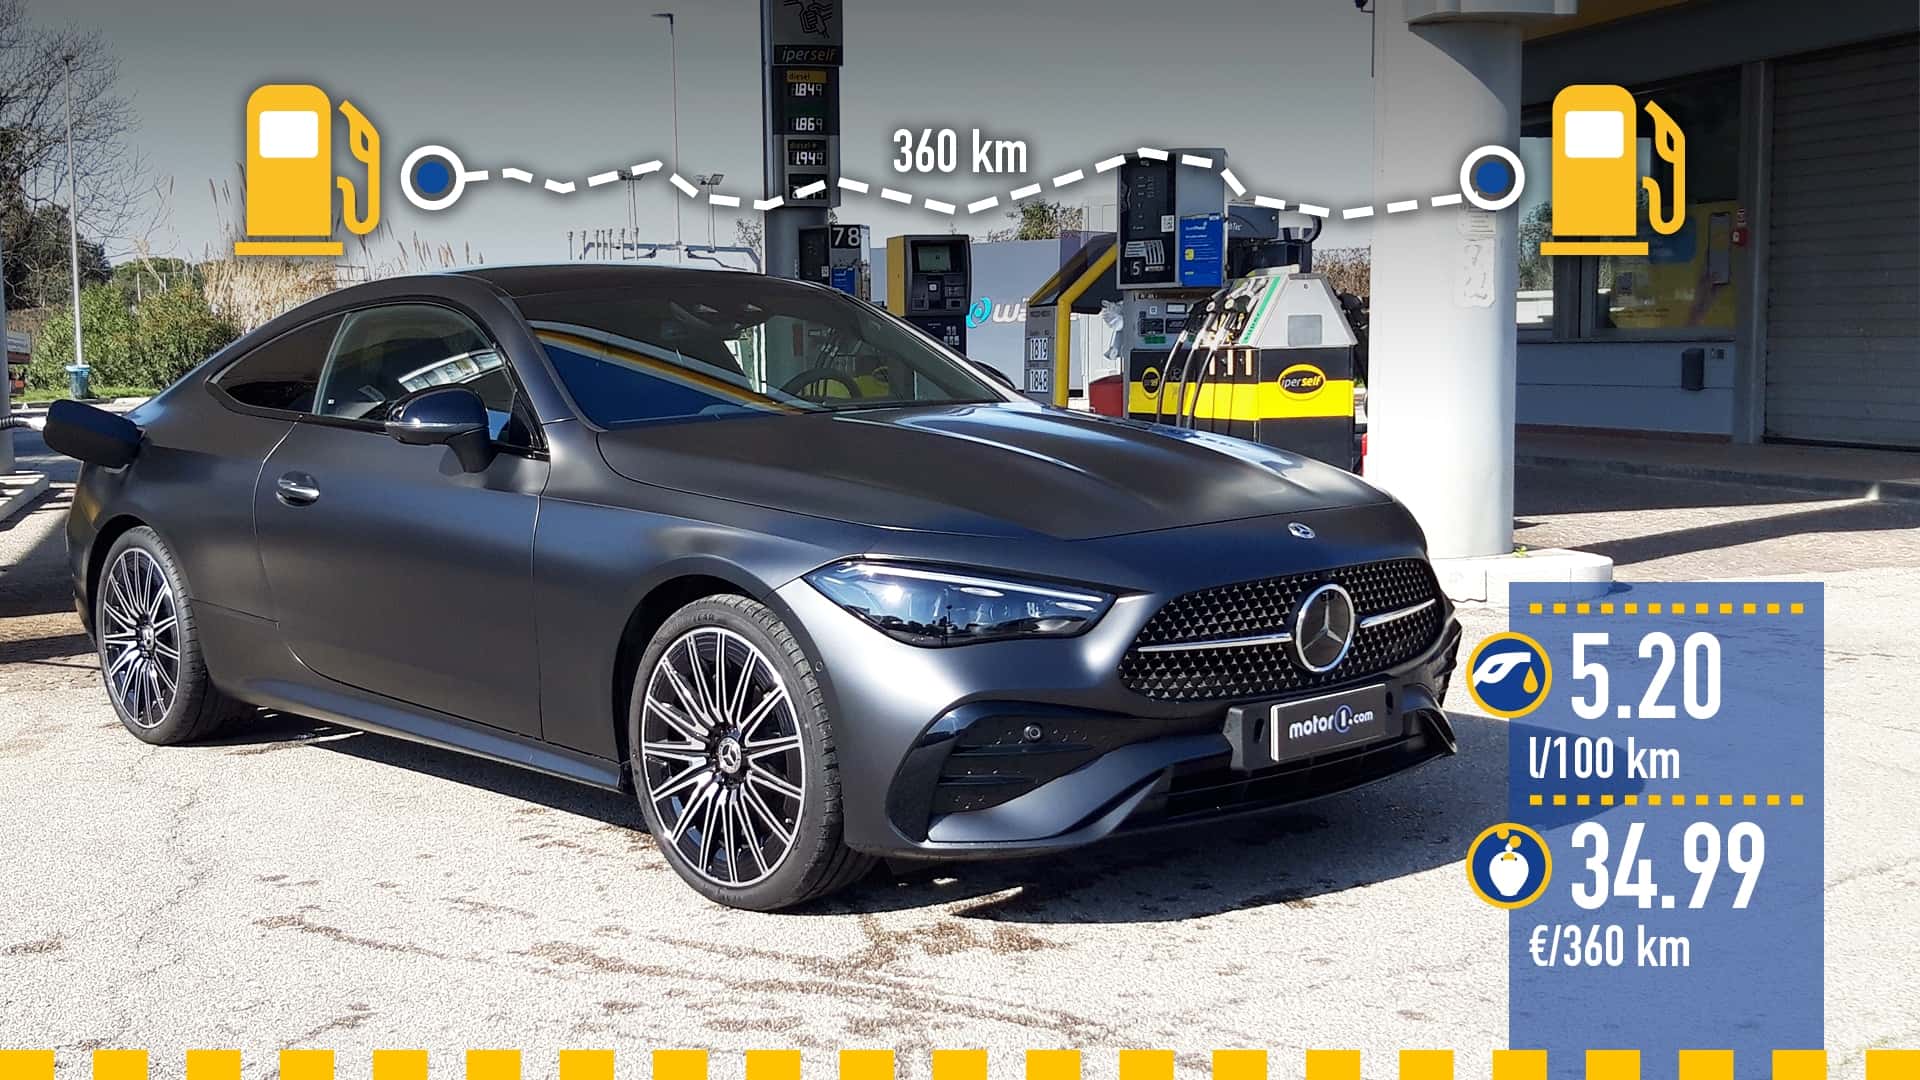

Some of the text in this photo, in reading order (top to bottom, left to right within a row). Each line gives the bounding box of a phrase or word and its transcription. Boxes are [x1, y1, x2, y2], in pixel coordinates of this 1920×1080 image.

[782, 46, 837, 63] iperself
[1132, 261, 1140, 275] 5
[1281, 375, 1322, 389] iperself
